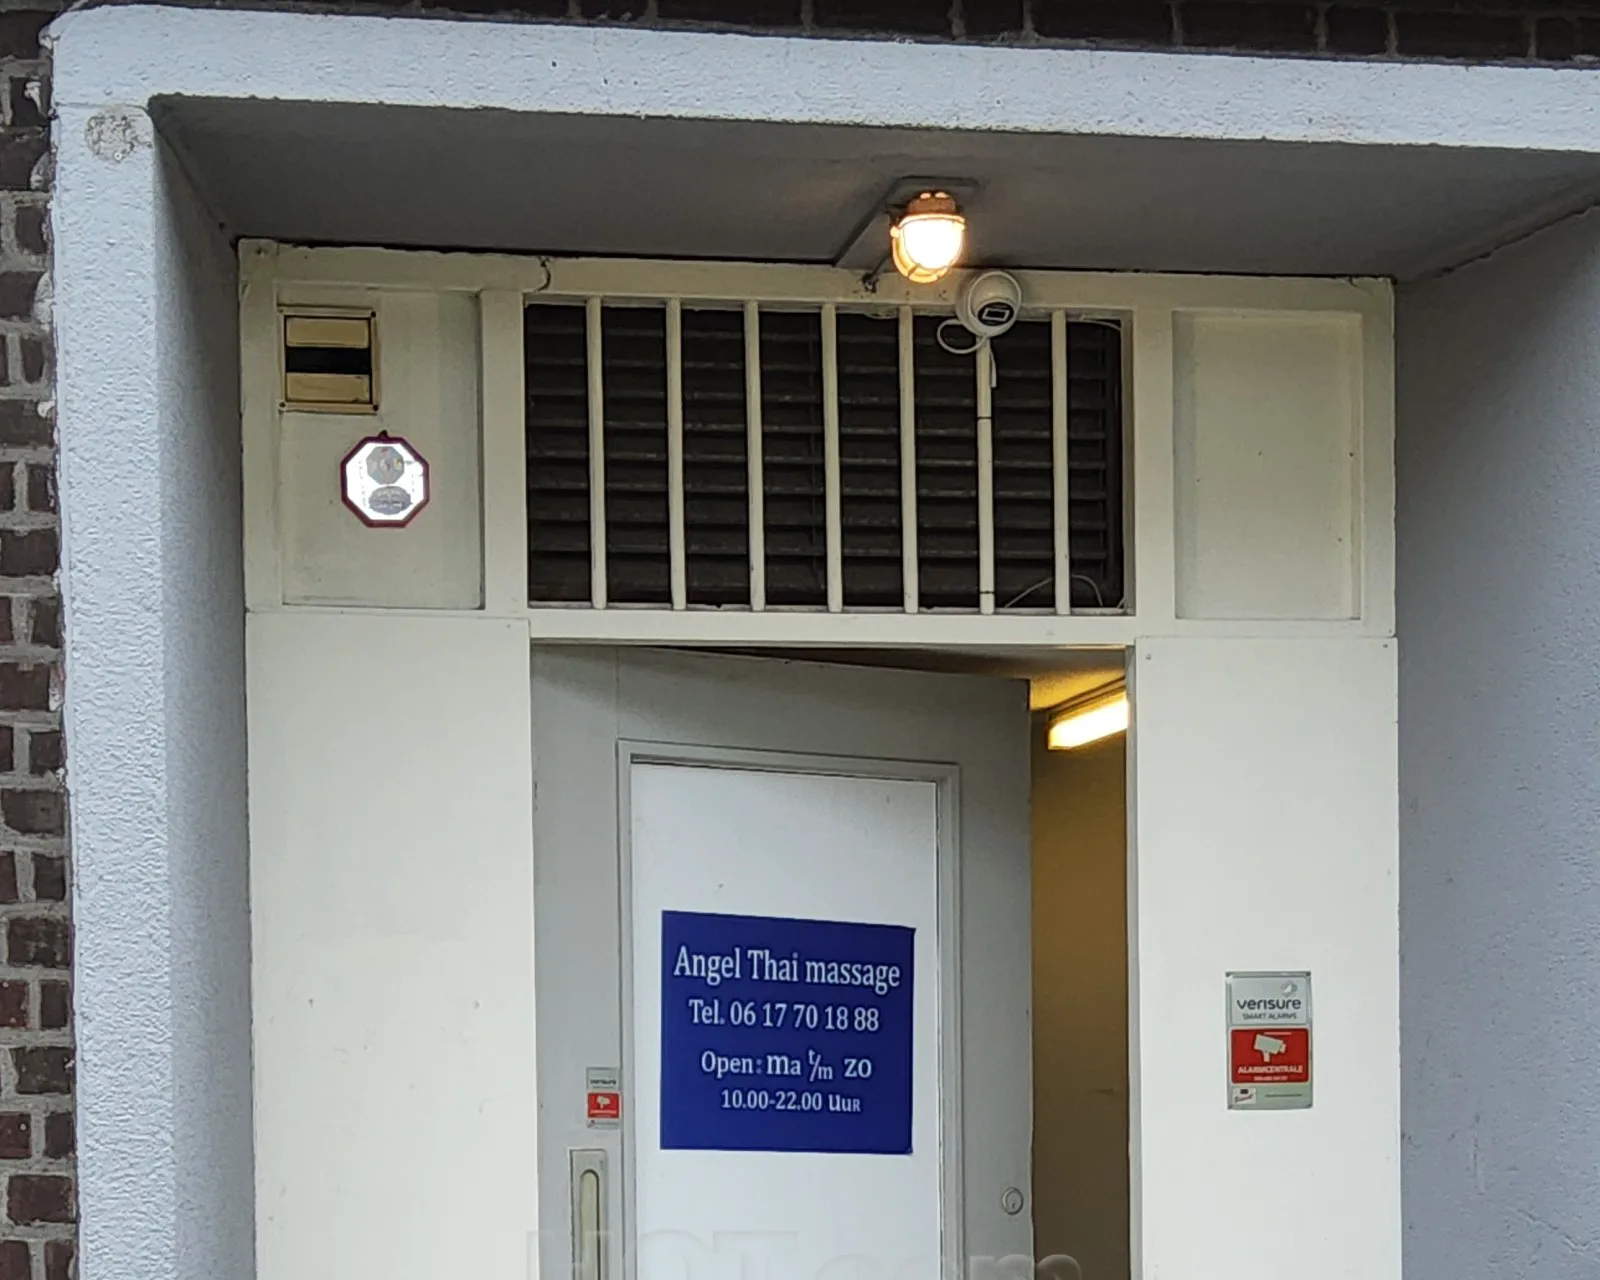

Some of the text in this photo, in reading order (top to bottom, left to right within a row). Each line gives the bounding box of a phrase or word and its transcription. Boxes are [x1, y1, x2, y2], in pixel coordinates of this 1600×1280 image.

[673, 945, 900, 994] Angel Thai massage
[688, 999, 879, 1031] Tel. 06 17 70 18 88
[1236, 998, 1302, 1010] verisure
[766, 1054, 801, 1076] ma
[721, 1089, 823, 1111] 10.00-22.00
